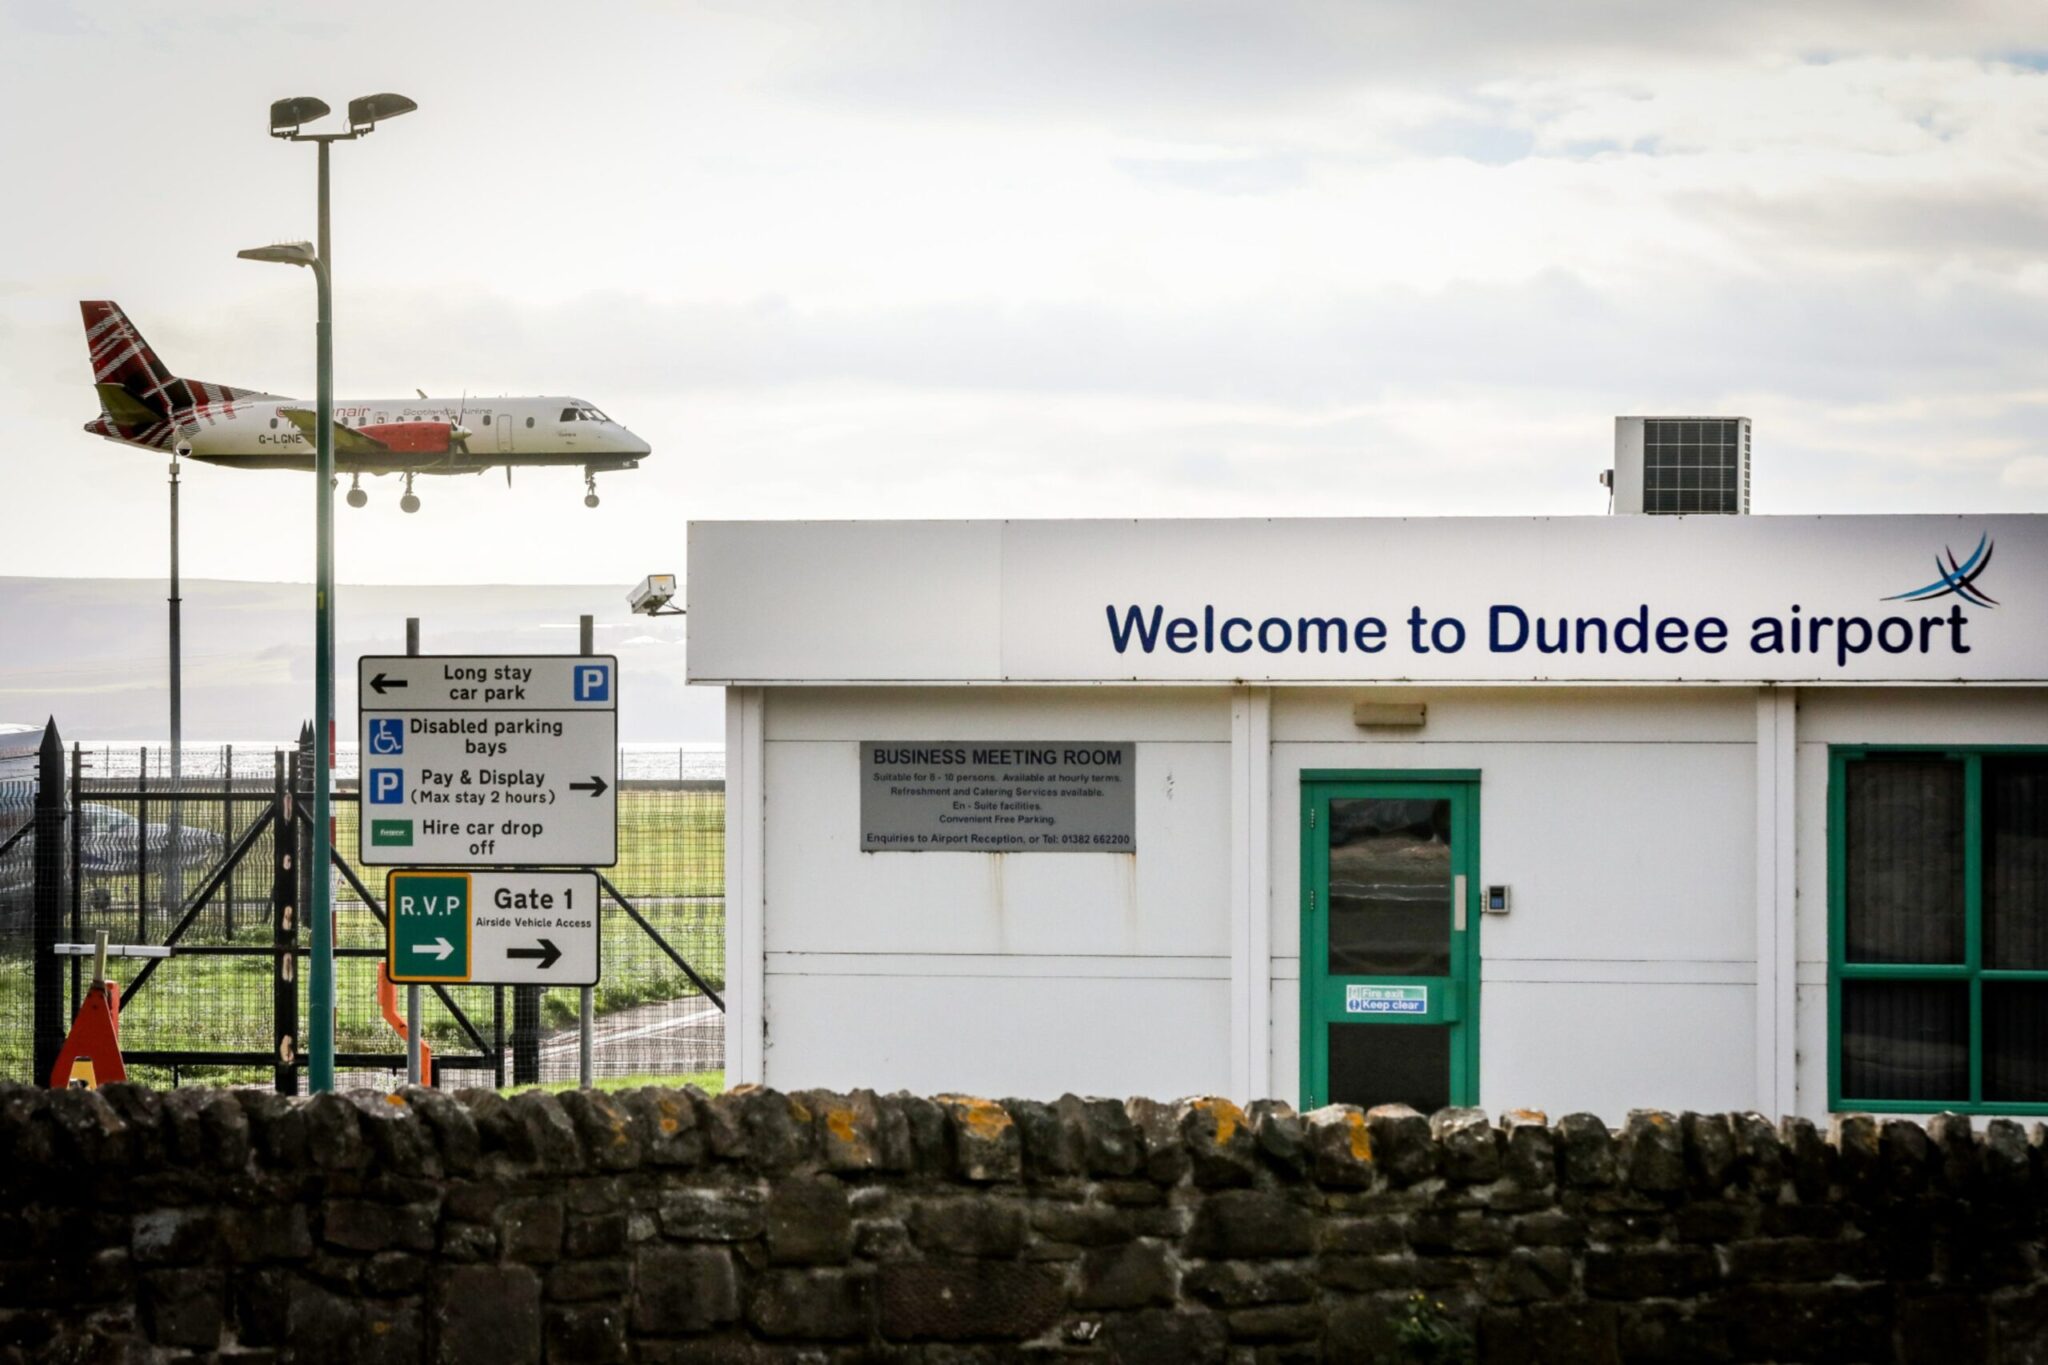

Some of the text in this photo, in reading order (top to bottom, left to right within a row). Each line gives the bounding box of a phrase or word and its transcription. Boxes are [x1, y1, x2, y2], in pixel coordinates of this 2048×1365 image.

[259, 434, 302, 444] G-LGNE
[1107, 605, 1970, 666] Welcome to Dundee airport
[444, 664, 532, 683] Long stay
[450, 685, 526, 702] car park
[410, 719, 563, 736] Disabled parking
[466, 739, 507, 757] bays
[874, 749, 1122, 765] BUSINESS MEETING ROOM
[421, 769, 545, 788] Pay & Display
[873, 773, 912, 782] Suitable
[914, 773, 927, 781] for
[944, 773, 954, 781] 10
[1003, 774, 1045, 782] Available
[1047, 774, 1056, 782] at
[1059, 774, 1089, 784] hourly
[1091, 775, 1122, 783] terms.
[410, 790, 556, 806] (Max stay 2 hours)
[891, 787, 1104, 798] Refreshment and Catering Services available.
[953, 801, 965, 810] En
[974, 801, 998, 810] Suite
[1000, 802, 1042, 811] facilities.
[939, 814, 992, 824] Convenient
[994, 815, 1016, 824] Free
[423, 820, 460, 835] Hire
[466, 823, 494, 835] car
[501, 820, 543, 838] drop
[866, 833, 915, 844] Enquiries
[918, 834, 928, 843] to
[930, 833, 968, 845] Airport
[1028, 835, 1039, 844] or
[1042, 834, 1059, 844] Tel:
[1061, 835, 1090, 844] 01382
[1093, 835, 1130, 845] 662200
[469, 840, 495, 855] off
[401, 896, 460, 917] R.V.P
[494, 888, 573, 910] Gate 1
[476, 917, 592, 928] Airside Vehicle Access
[1362, 988, 1404, 998] Fire exit
[1362, 1000, 1419, 1011] Keep clear
